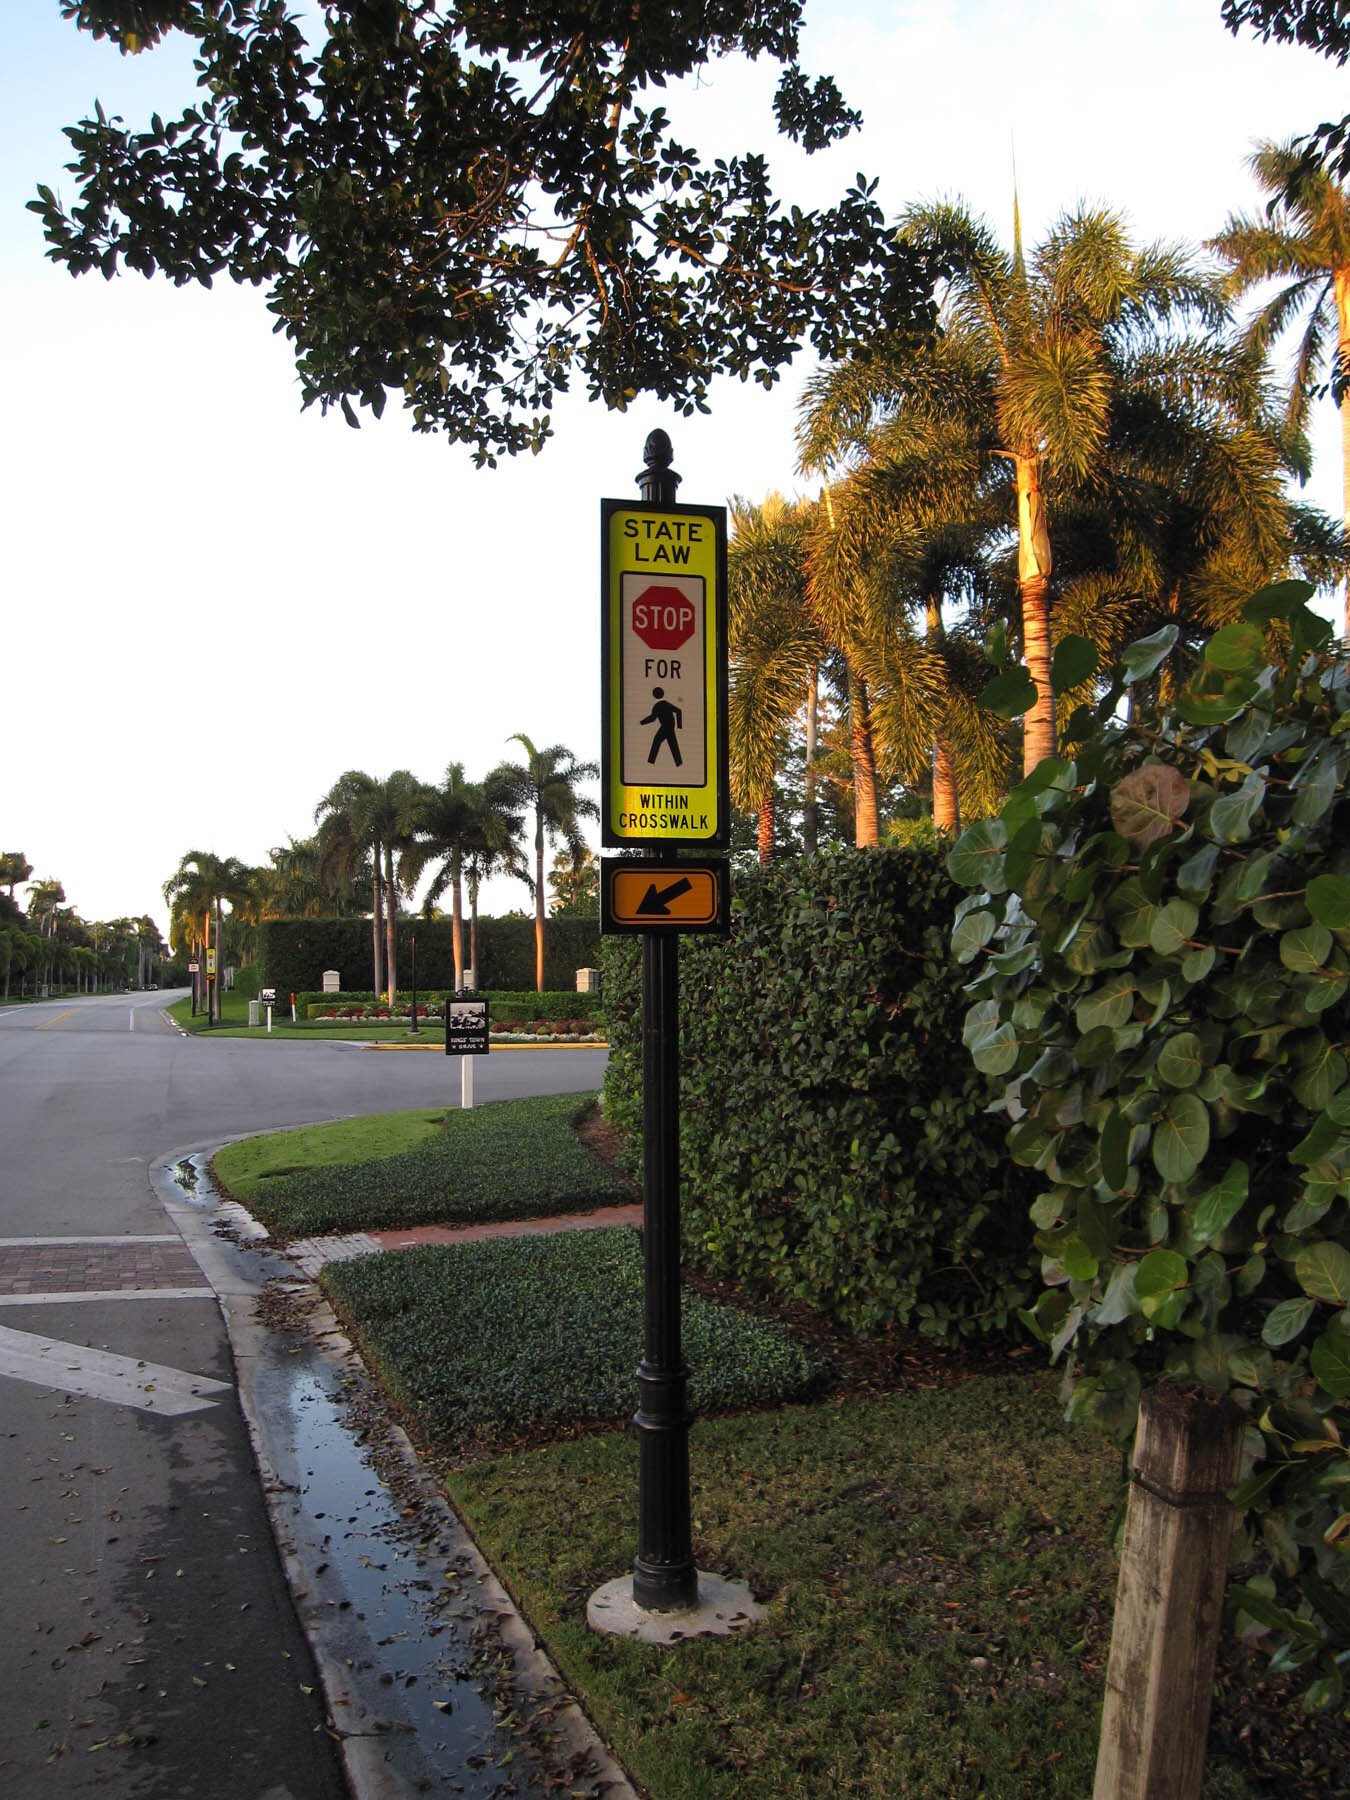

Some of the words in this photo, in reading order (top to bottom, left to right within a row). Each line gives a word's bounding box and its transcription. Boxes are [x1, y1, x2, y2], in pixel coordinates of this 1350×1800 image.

[624, 519, 702, 542] STATE
[635, 543, 691, 564] LAW
[635, 605, 693, 631] STOP
[645, 659, 681, 679] FOR
[640, 794, 689, 809] WITHIN
[619, 814, 709, 829] CROSSWALK
